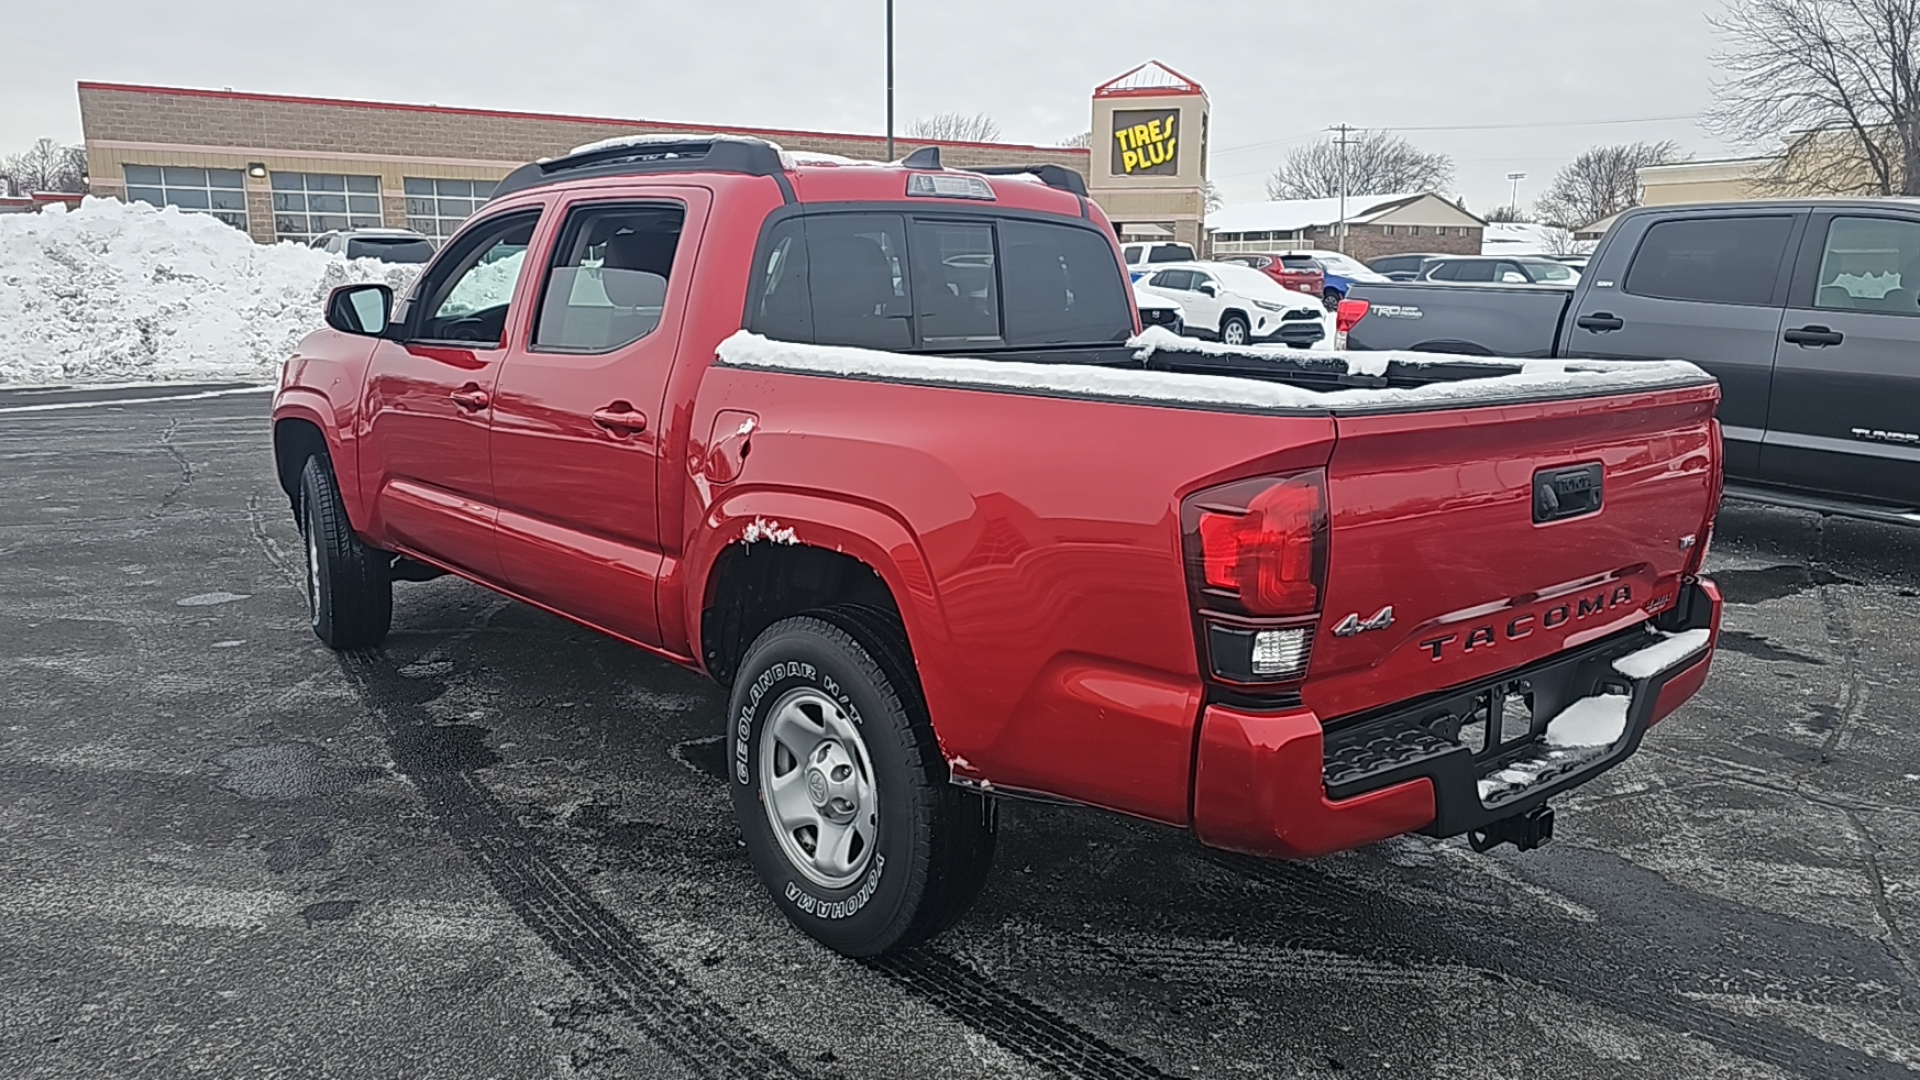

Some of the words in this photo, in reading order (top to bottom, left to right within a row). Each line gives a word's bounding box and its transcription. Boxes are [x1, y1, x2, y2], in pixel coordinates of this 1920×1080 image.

[1115, 115, 1175, 151] TIRES
[1122, 137, 1176, 173] PLUS
[1370, 305, 1400, 317] TRD
[1420, 584, 1633, 664] TACOMA
[737, 661, 817, 785] GEOLANDAR
[785, 852, 885, 919] YOKOHAMA
